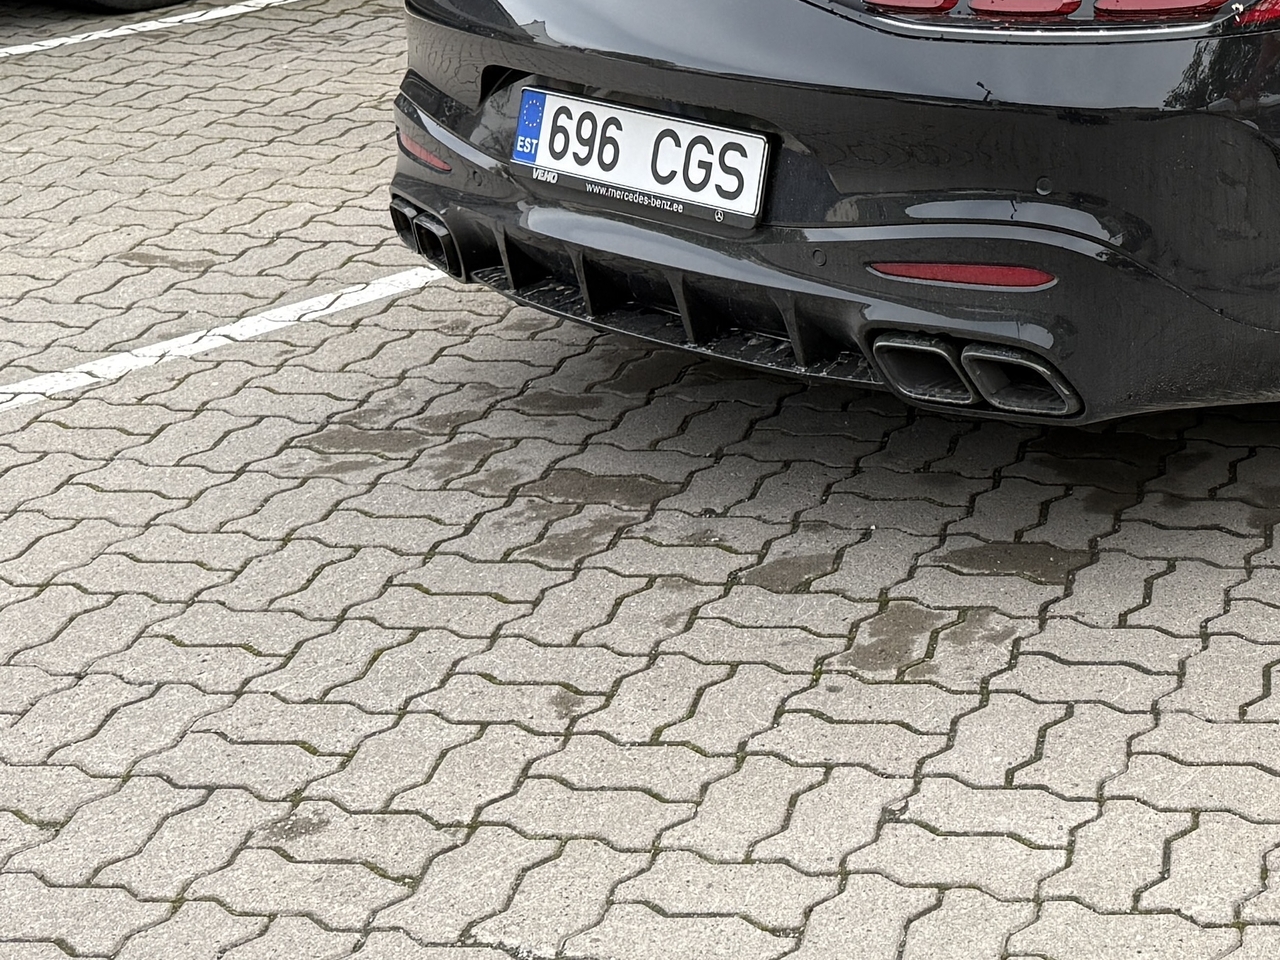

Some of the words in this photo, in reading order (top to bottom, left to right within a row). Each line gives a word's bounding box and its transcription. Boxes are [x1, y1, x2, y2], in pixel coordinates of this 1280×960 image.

[517, 136, 538, 154] EST
[549, 106, 623, 172] 696
[650, 128, 748, 200] CGS
[532, 168, 558, 184] VEHO
[586, 183, 683, 213] www.mercedes-benz.ee
